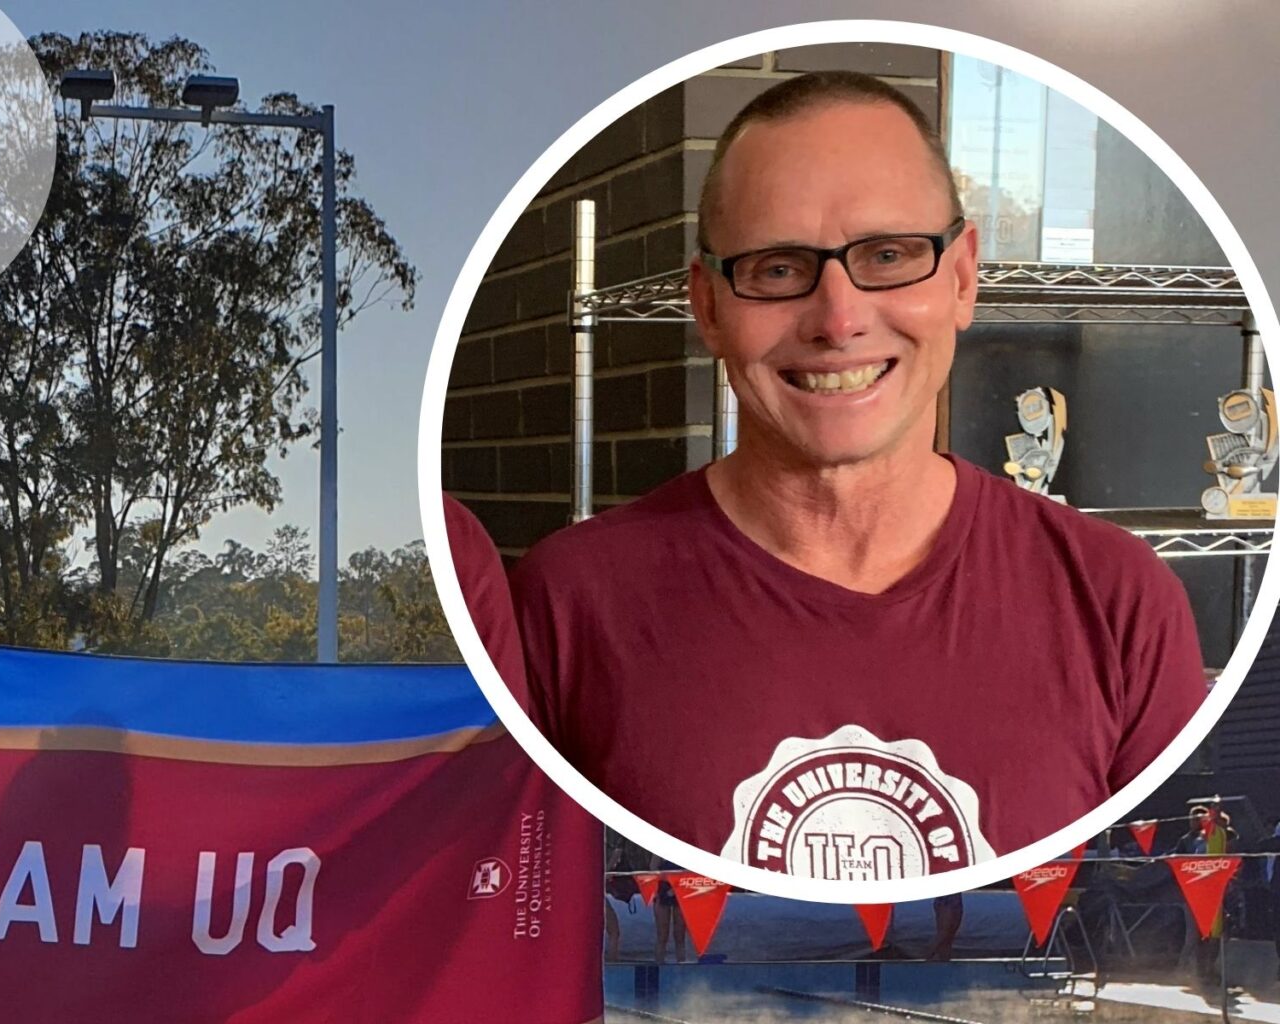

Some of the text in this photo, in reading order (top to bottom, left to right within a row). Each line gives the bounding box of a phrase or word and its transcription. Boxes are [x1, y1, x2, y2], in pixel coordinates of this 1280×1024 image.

[757, 763, 960, 863] THE UNIVERSITY OF
[840, 859, 873, 870] TEAM
[192, 847, 322, 955] UQ
[513, 812, 533, 939] THE UNIVERSITY
[528, 809, 545, 938] OF QUEENSLAND
[1180, 858, 1232, 874] speedo
